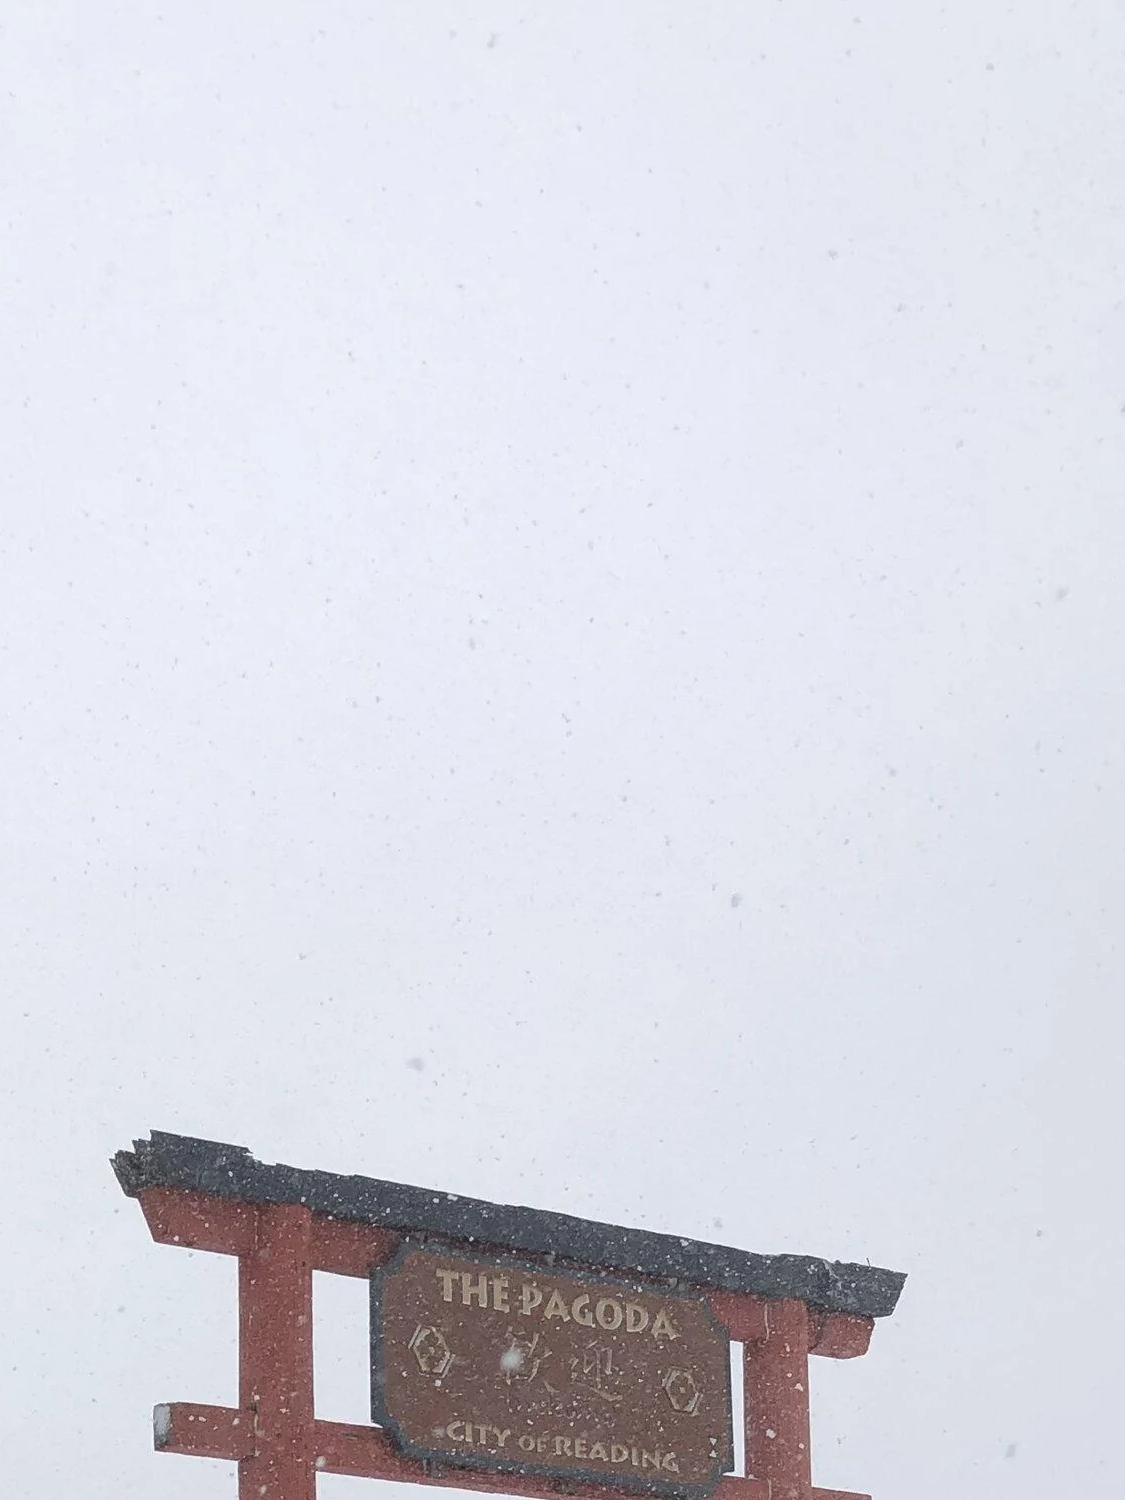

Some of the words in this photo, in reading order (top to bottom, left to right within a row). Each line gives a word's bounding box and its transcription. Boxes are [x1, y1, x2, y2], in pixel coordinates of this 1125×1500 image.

[435, 1267, 510, 1314] THE
[522, 1284, 682, 1341] PAGODA
[446, 1420, 511, 1447] CITY
[552, 1435, 680, 1474] READING
